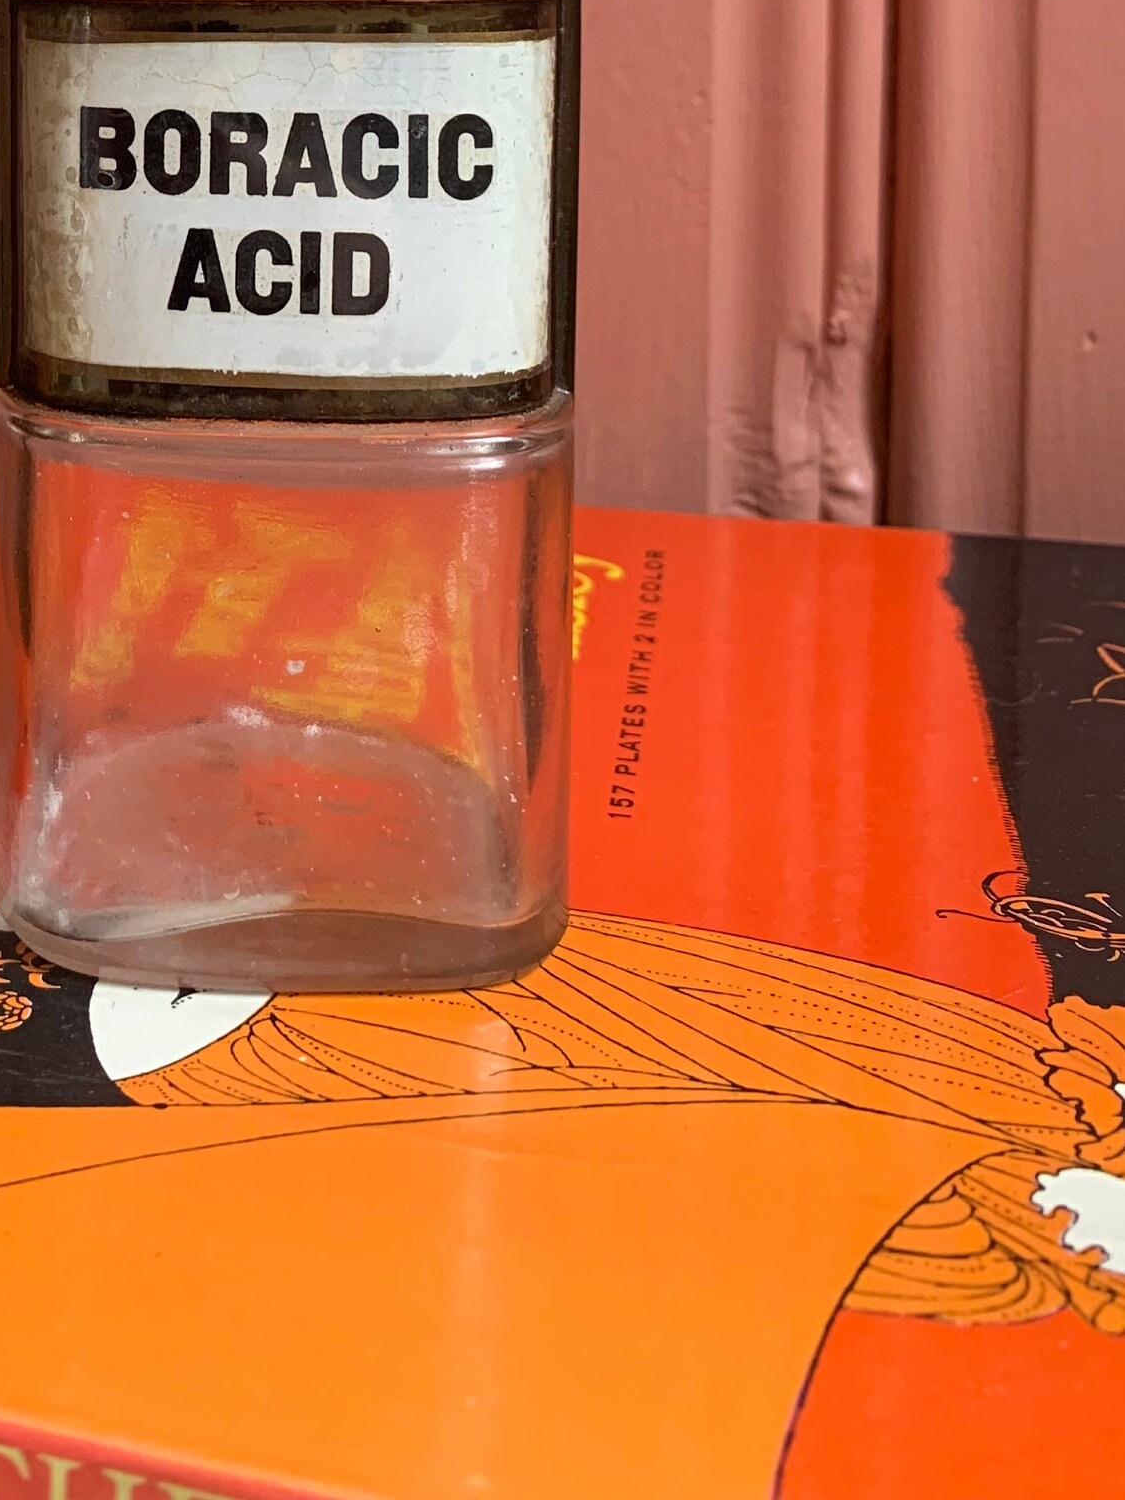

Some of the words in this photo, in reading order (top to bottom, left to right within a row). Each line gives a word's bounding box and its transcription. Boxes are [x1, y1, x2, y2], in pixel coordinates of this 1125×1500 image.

[79, 106, 494, 201] BORACIC
[167, 228, 391, 316] ACID
[639, 549, 664, 604] COLOR
[635, 634, 657, 645] 2
[637, 609, 658, 629] IN
[627, 651, 654, 694] WITH
[615, 704, 647, 776] PLATES
[608, 784, 636, 819] 157
